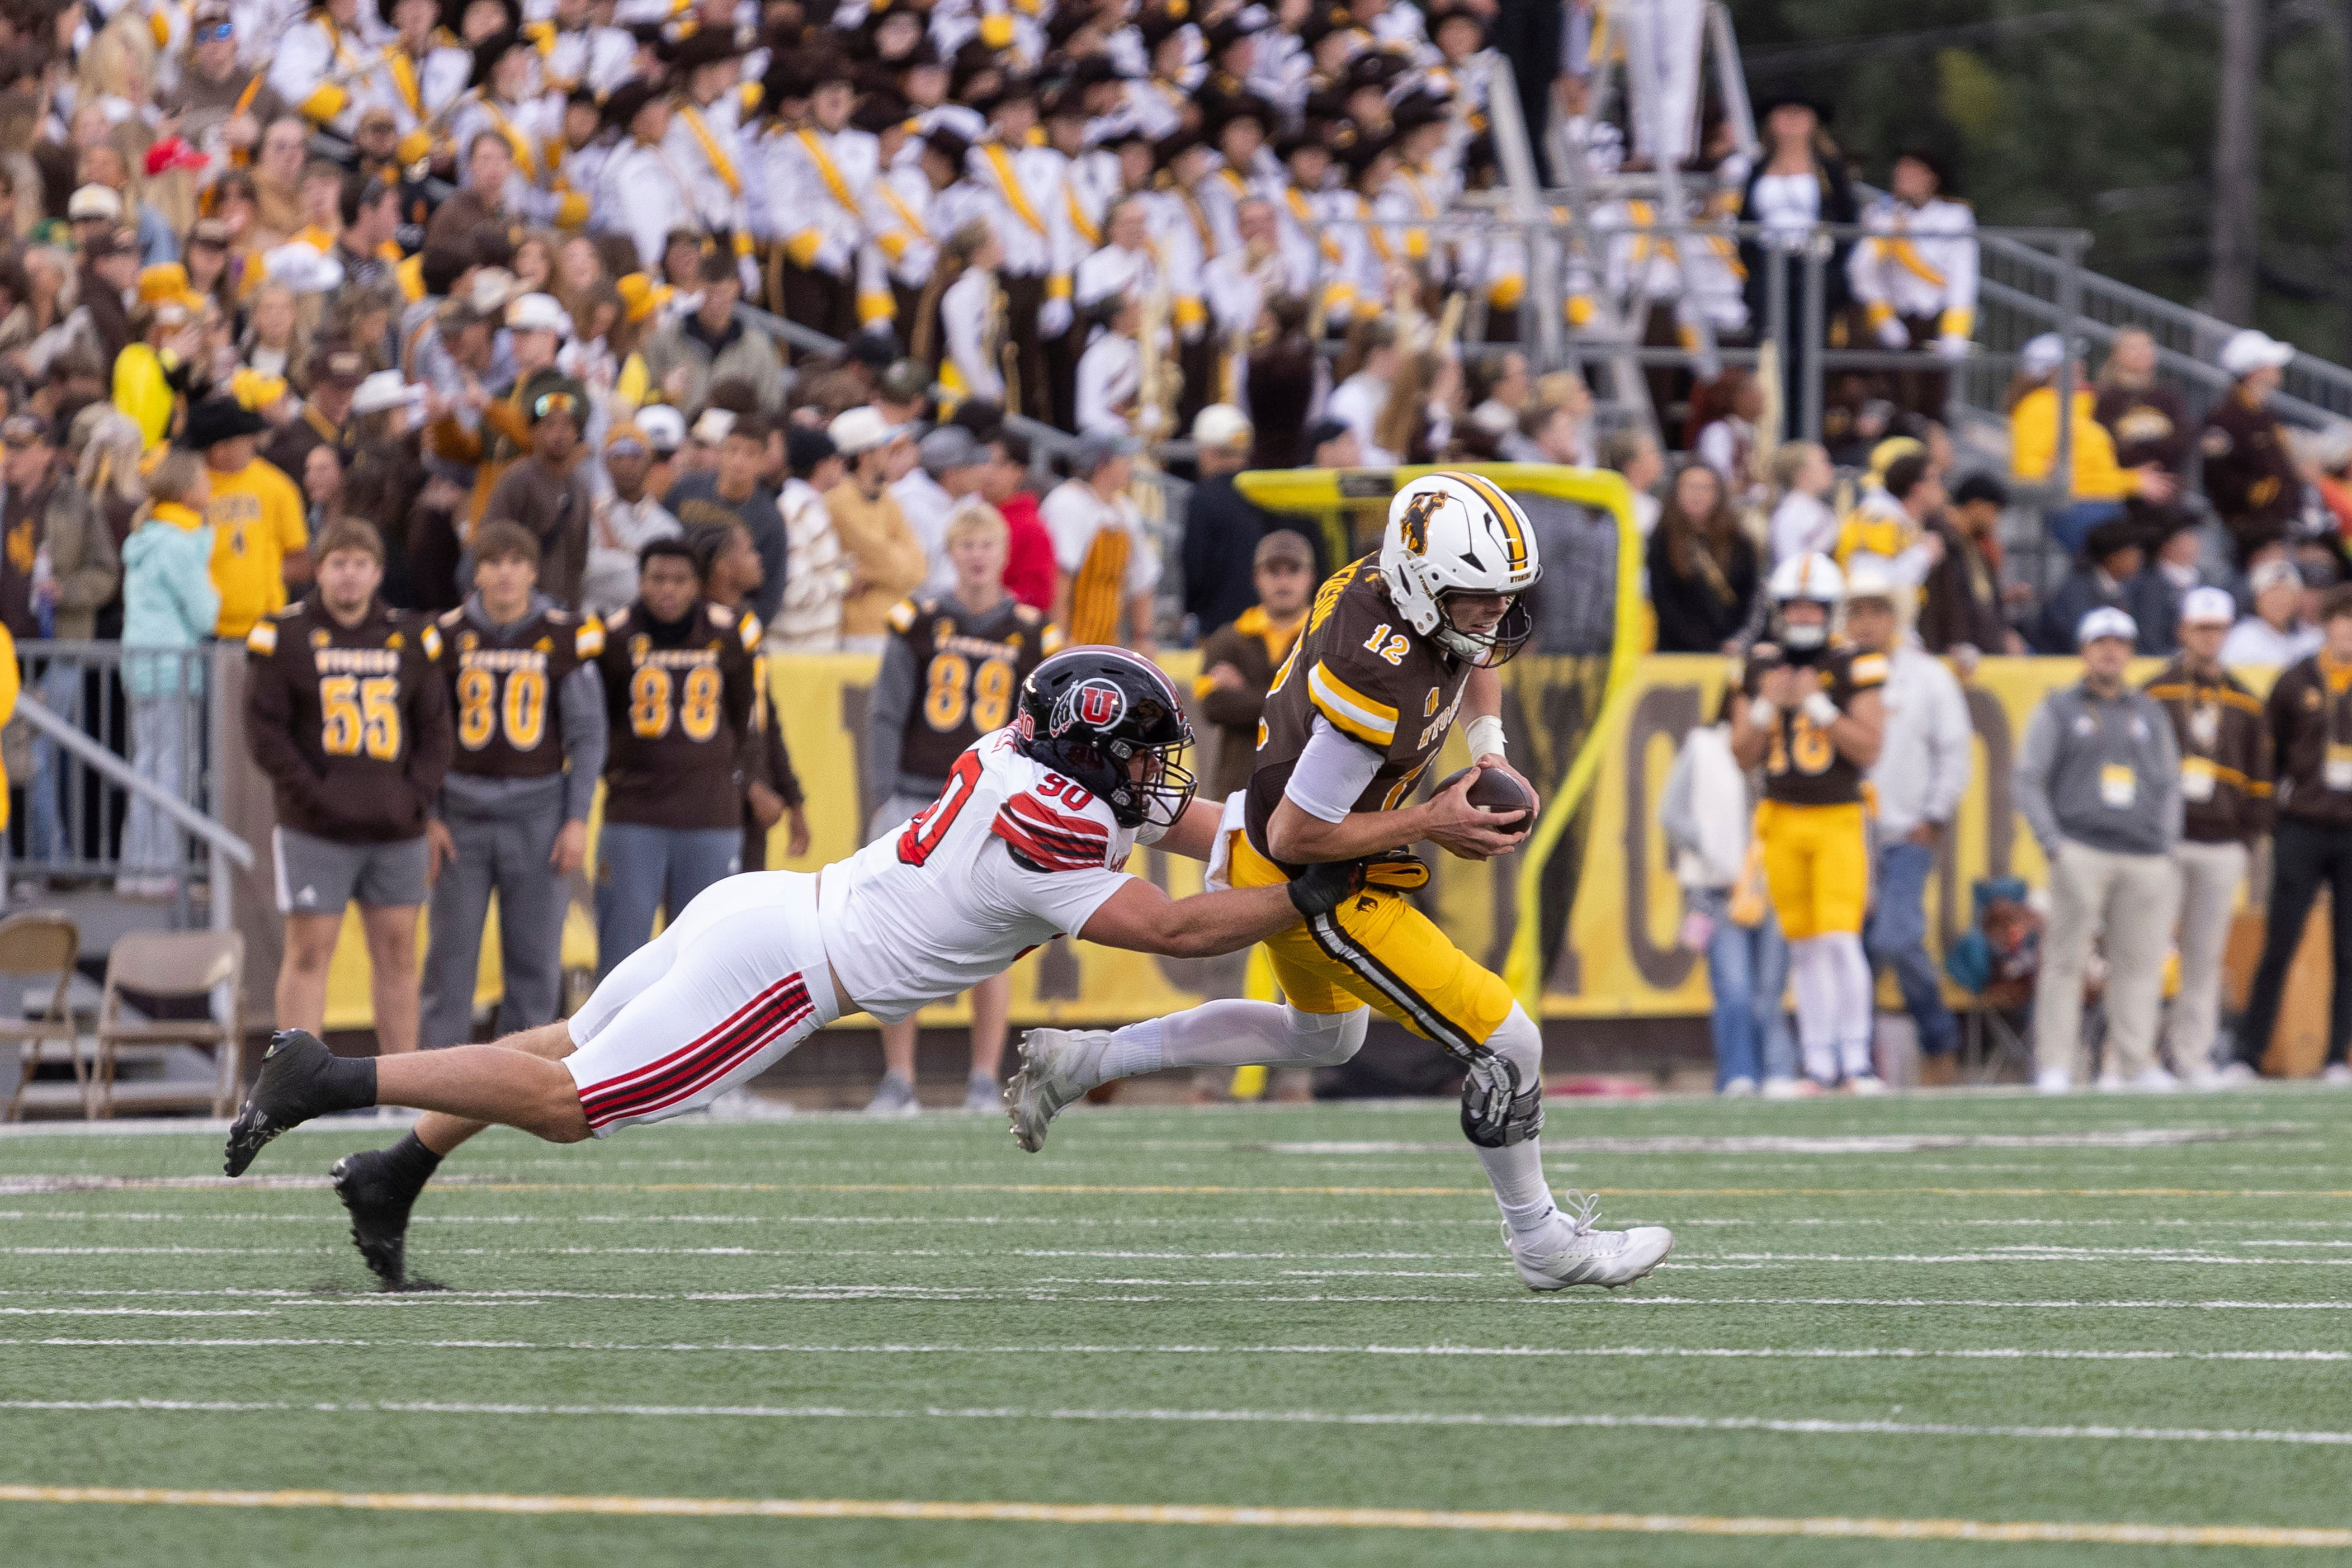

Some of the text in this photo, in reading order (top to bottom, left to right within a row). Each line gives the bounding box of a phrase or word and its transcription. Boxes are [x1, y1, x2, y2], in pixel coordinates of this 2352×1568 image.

[1363, 623, 1410, 665] 12
[319, 674, 402, 761] 55
[456, 668, 551, 750] 80
[628, 666, 725, 743] 88
[924, 653, 1016, 733] 89
[1080, 686, 1118, 725] U
[896, 748, 984, 867] 0
[1036, 773, 1094, 811] 90
